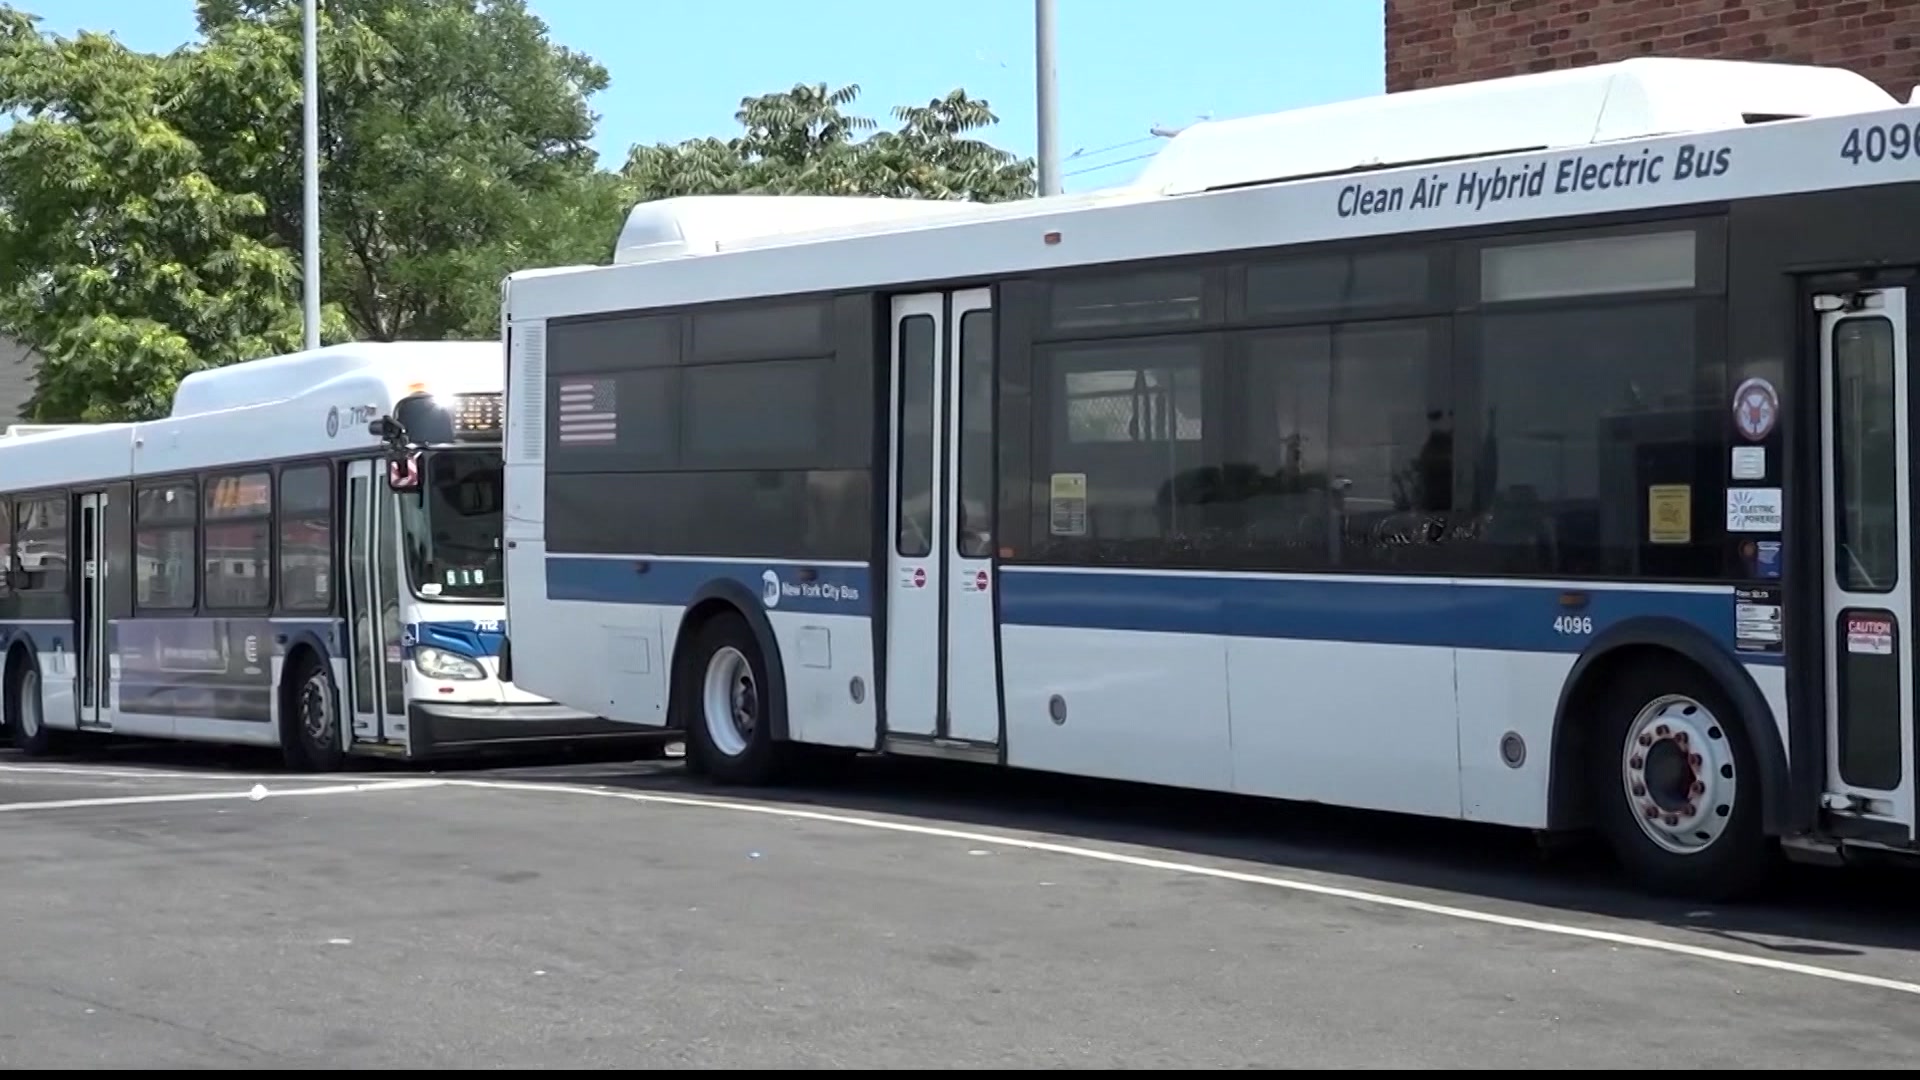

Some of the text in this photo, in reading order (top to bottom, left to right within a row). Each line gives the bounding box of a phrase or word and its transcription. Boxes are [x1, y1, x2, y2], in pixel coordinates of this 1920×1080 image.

[1337, 143, 1732, 218] Clean Air Hybrid Electric Bus
[782, 582, 859, 601] New York City Bus
[1553, 615, 1593, 635] 4096
[1848, 620, 1891, 634] CAUTION
